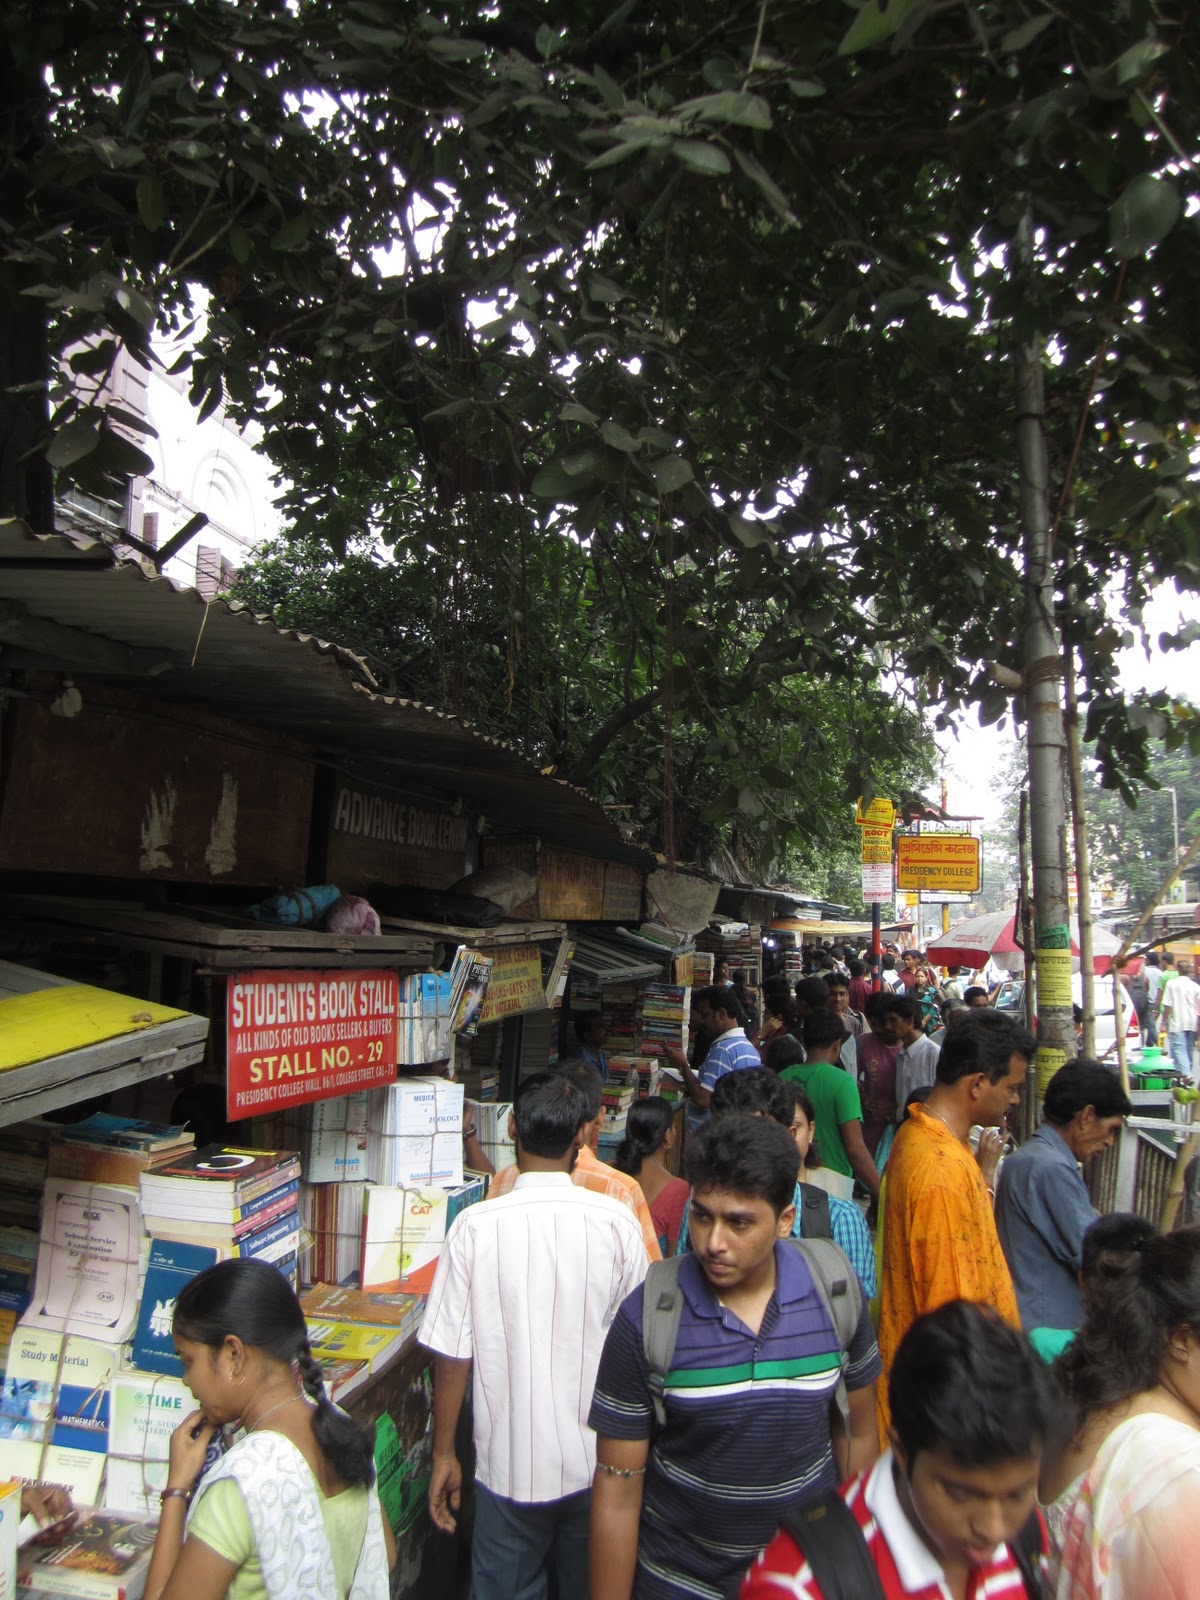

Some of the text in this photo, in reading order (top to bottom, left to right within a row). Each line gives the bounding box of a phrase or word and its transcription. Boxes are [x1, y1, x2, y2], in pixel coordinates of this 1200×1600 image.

[334, 787, 406, 844] ADVANCE
[407, 805, 436, 848] BOOK
[864, 829, 889, 838] ROOT
[900, 840, 976, 854] প্রেসিডেন্সি কলেজ
[901, 866, 974, 877] PRESIDENCY COLLEGE
[233, 980, 394, 1028] STUDENTS BOOK STALL
[236, 1018, 393, 1054] ALL KINDS OF OLD BOOKS SELLERS & BUYERS
[250, 1050, 317, 1084] STALL
[321, 1045, 354, 1071] NO.
[367, 1040, 384, 1063] 29
[236, 1087, 278, 1107] PRESIDENCY
[278, 1082, 304, 1098] COLLEGE
[305, 1079, 322, 1094] WALL,
[336, 1071, 358, 1086] COLLEGE
[358, 1068, 376, 1081] STREET,
[375, 1066, 384, 1077] CAL
[428, 1115, 460, 1124] ZOOLOGY
[317, 1102, 325, 1156] MATHEMATICS
[334, 1157, 360, 1165] Aakash
[410, 1204, 432, 1216] CAT
[64, 1231, 117, 1245] School Service
[68, 1240, 113, 1254] Examination
[21, 1349, 89, 1367] Study Mterial
[146, 1394, 183, 1409] TIME
[62, 1415, 105, 1428] MATHEMATICS
[133, 1417, 154, 1427] BASC
[137, 1425, 173, 1436] MATERIA
